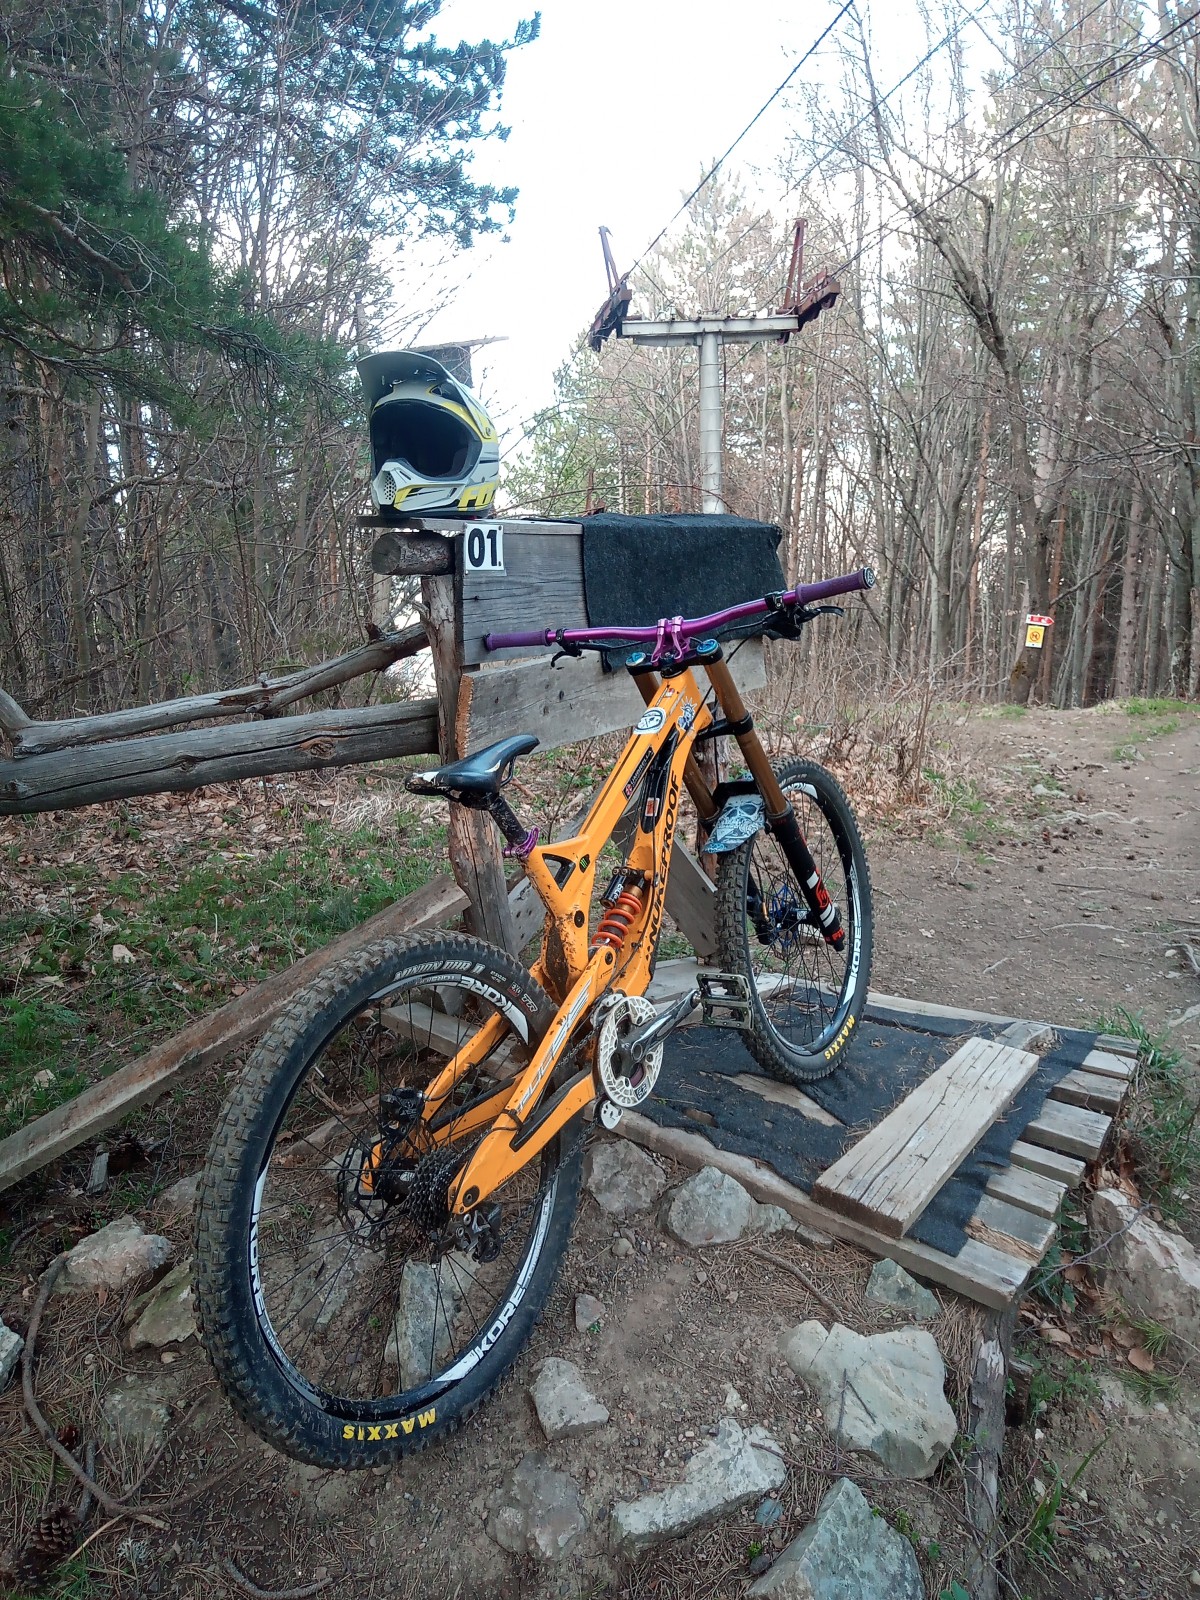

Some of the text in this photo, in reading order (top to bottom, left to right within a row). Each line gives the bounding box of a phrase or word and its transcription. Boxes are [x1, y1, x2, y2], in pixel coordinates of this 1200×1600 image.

[457, 482, 497, 512] FO
[467, 528, 498, 567] 01
[647, 773, 680, 944] NUKEPROOF
[394, 960, 444, 981] MINION
[442, 959, 473, 972] DHR
[851, 925, 863, 978] KORE
[457, 975, 513, 1013] KORE
[824, 1014, 857, 1061] MAXXIS
[249, 1213, 265, 1316] KORE
[474, 1286, 527, 1362] KORE
[341, 1407, 437, 1442] MAXXIS
